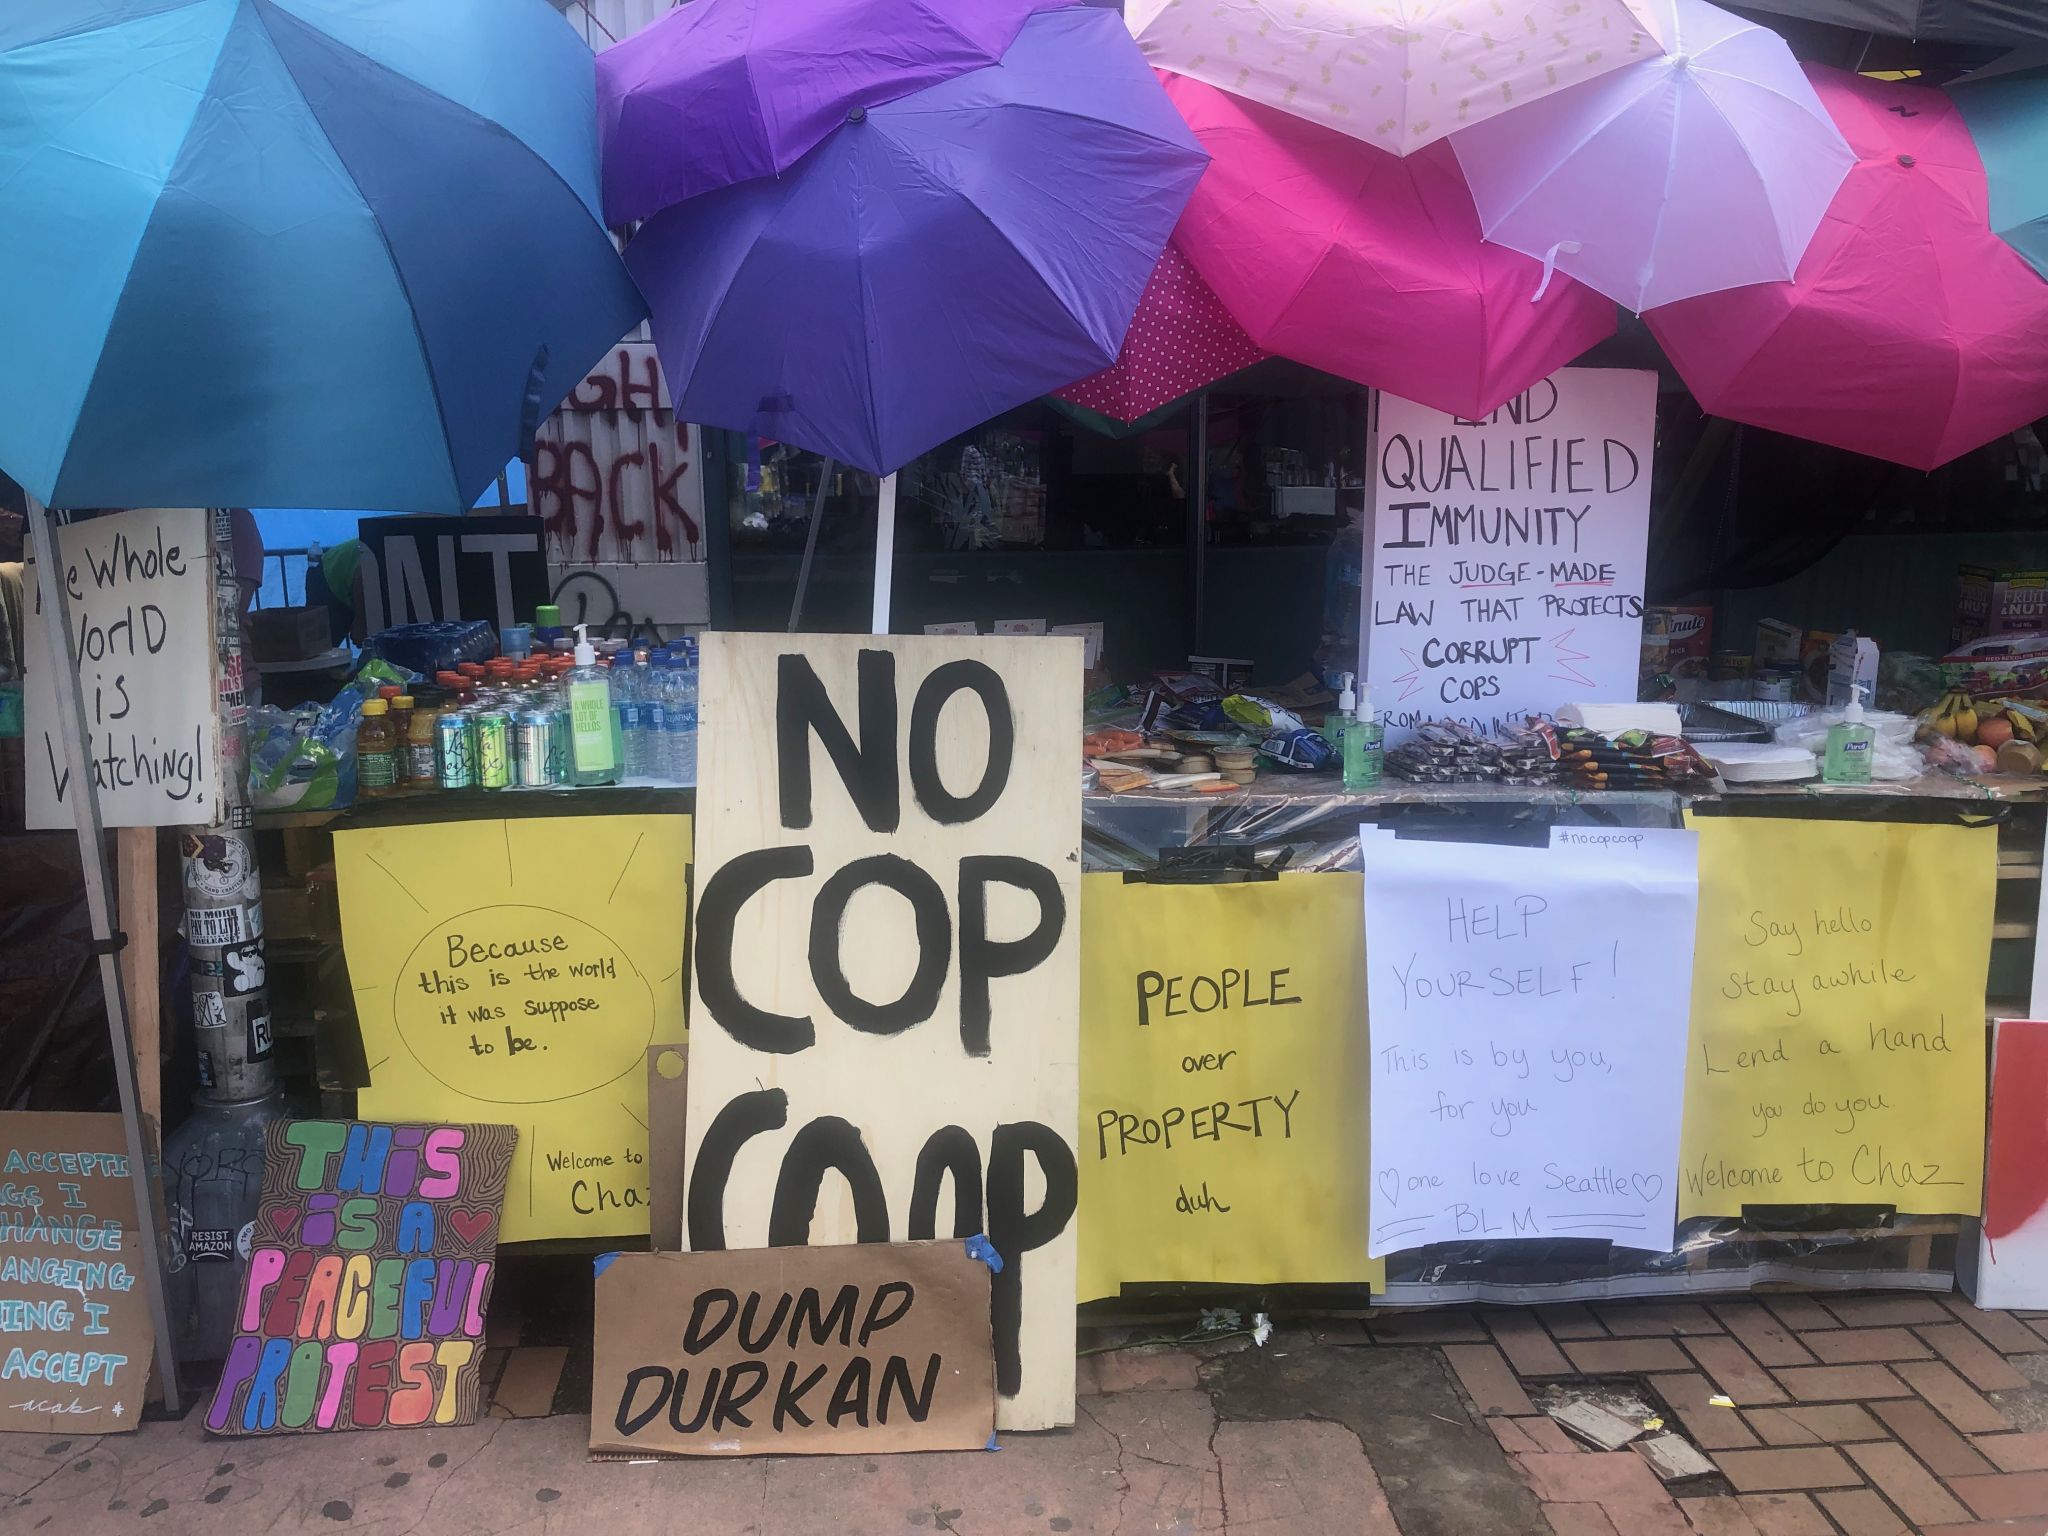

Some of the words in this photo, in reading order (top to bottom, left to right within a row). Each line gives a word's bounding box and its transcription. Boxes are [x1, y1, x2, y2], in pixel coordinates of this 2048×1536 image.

[1453, 377, 1558, 427] ND
[1382, 434, 1639, 493] QUALIFIED
[530, 439, 700, 557] BACK
[1383, 502, 1591, 552] IMMUNITY
[85, 525, 187, 588] Whole
[1384, 564, 1431, 586] THE
[1375, 600, 1434, 626] LAW
[1460, 597, 1524, 622] THAT
[1538, 594, 1643, 619] PROTECTS
[1422, 637, 1541, 668] CORRUPT
[96, 674, 130, 724] is
[581, 698, 604, 710] WHOLE
[1441, 675, 1501, 703] COPS
[776, 648, 1015, 835] NO
[1559, 832, 1644, 849] #nocopcoop
[1448, 895, 1547, 942] HELP
[1744, 910, 1803, 956] Say
[1814, 907, 1872, 936] hello
[447, 934, 569, 968] Because
[695, 844, 1066, 1058] COP
[418, 971, 470, 996] this
[490, 969, 511, 988] is
[523, 962, 560, 981] the
[569, 958, 616, 979] world
[1137, 968, 1302, 1026] PEOPLE
[1813, 959, 1916, 991] awhile
[440, 1005, 457, 1025] it
[467, 1005, 506, 1022] was
[469, 1035, 494, 1056] to
[1182, 1050, 1237, 1073] over
[1380, 1044, 1429, 1072] This
[1454, 1044, 1474, 1067] is
[1491, 1040, 1530, 1079] by
[1551, 1047, 1613, 1082] you,
[1703, 1043, 1789, 1076] Lend
[1820, 1039, 1840, 1056] a
[1869, 1014, 1952, 1052] hand
[1097, 1090, 1300, 1160] PROPERTY
[1430, 1091, 1474, 1122] for
[1490, 1097, 1538, 1137] you
[1751, 1104, 1783, 1138] you
[1802, 1092, 1826, 1115] do
[1835, 1094, 1890, 1134] you
[546, 1150, 615, 1171] Welcome
[624, 1148, 642, 1164] to
[1407, 1172, 1444, 1189] one
[1472, 1161, 1520, 1186] love
[1544, 1162, 1631, 1197] Seattle
[1686, 1153, 1783, 1197] Welcome
[1797, 1146, 1834, 1182] to
[1852, 1143, 1965, 1186] Chaz
[58, 1182, 87, 1208] I
[1176, 1182, 1230, 1212] duh
[192, 1231, 229, 1240] RESIST
[397, 1201, 435, 1254] A
[1444, 1202, 1539, 1235] BLM
[189, 1241, 232, 1251] AMAZON
[688, 1088, 1078, 1399] COOP
[241, 1248, 490, 1340] PEACEFUL
[83, 1302, 110, 1335] I
[683, 1281, 915, 1356] DUMP
[1, 1347, 128, 1386] ACCEPT
[206, 1335, 474, 1431] PROTEST
[615, 1353, 941, 1436] DURKAN
